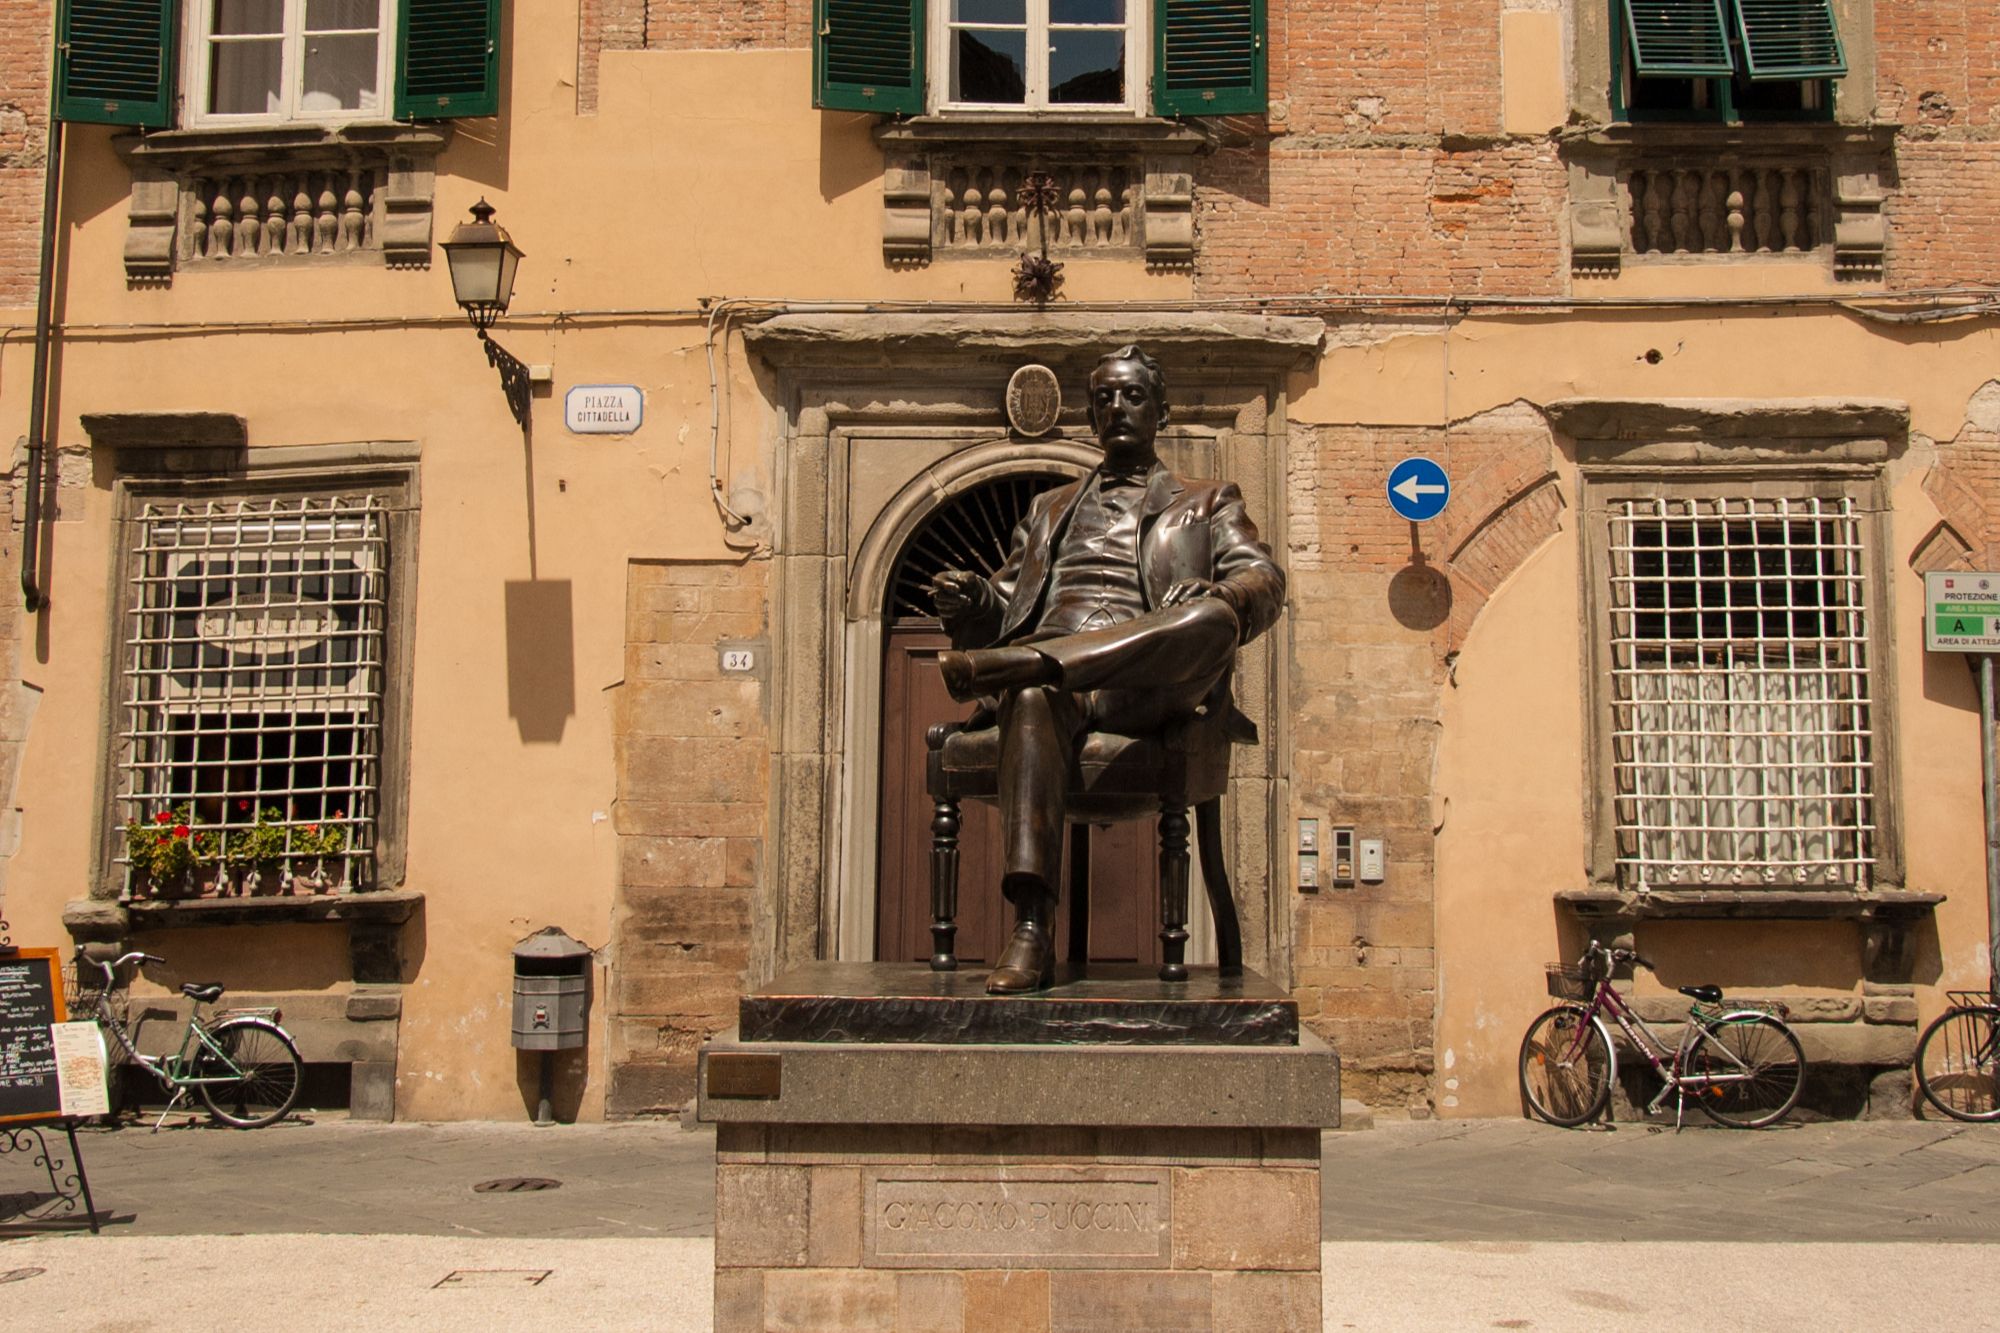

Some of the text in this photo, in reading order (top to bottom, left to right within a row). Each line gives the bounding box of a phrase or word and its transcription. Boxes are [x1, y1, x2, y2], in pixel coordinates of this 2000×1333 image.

[585, 396, 623, 408] PIAZZA
[577, 411, 630, 422] CITTADELLA
[1944, 592, 1998, 600] PROTEZIONE
[1953, 619, 1965, 632] A
[730, 653, 748, 668] 34
[884, 1201, 1149, 1232] GIACOMO PUCCINI
